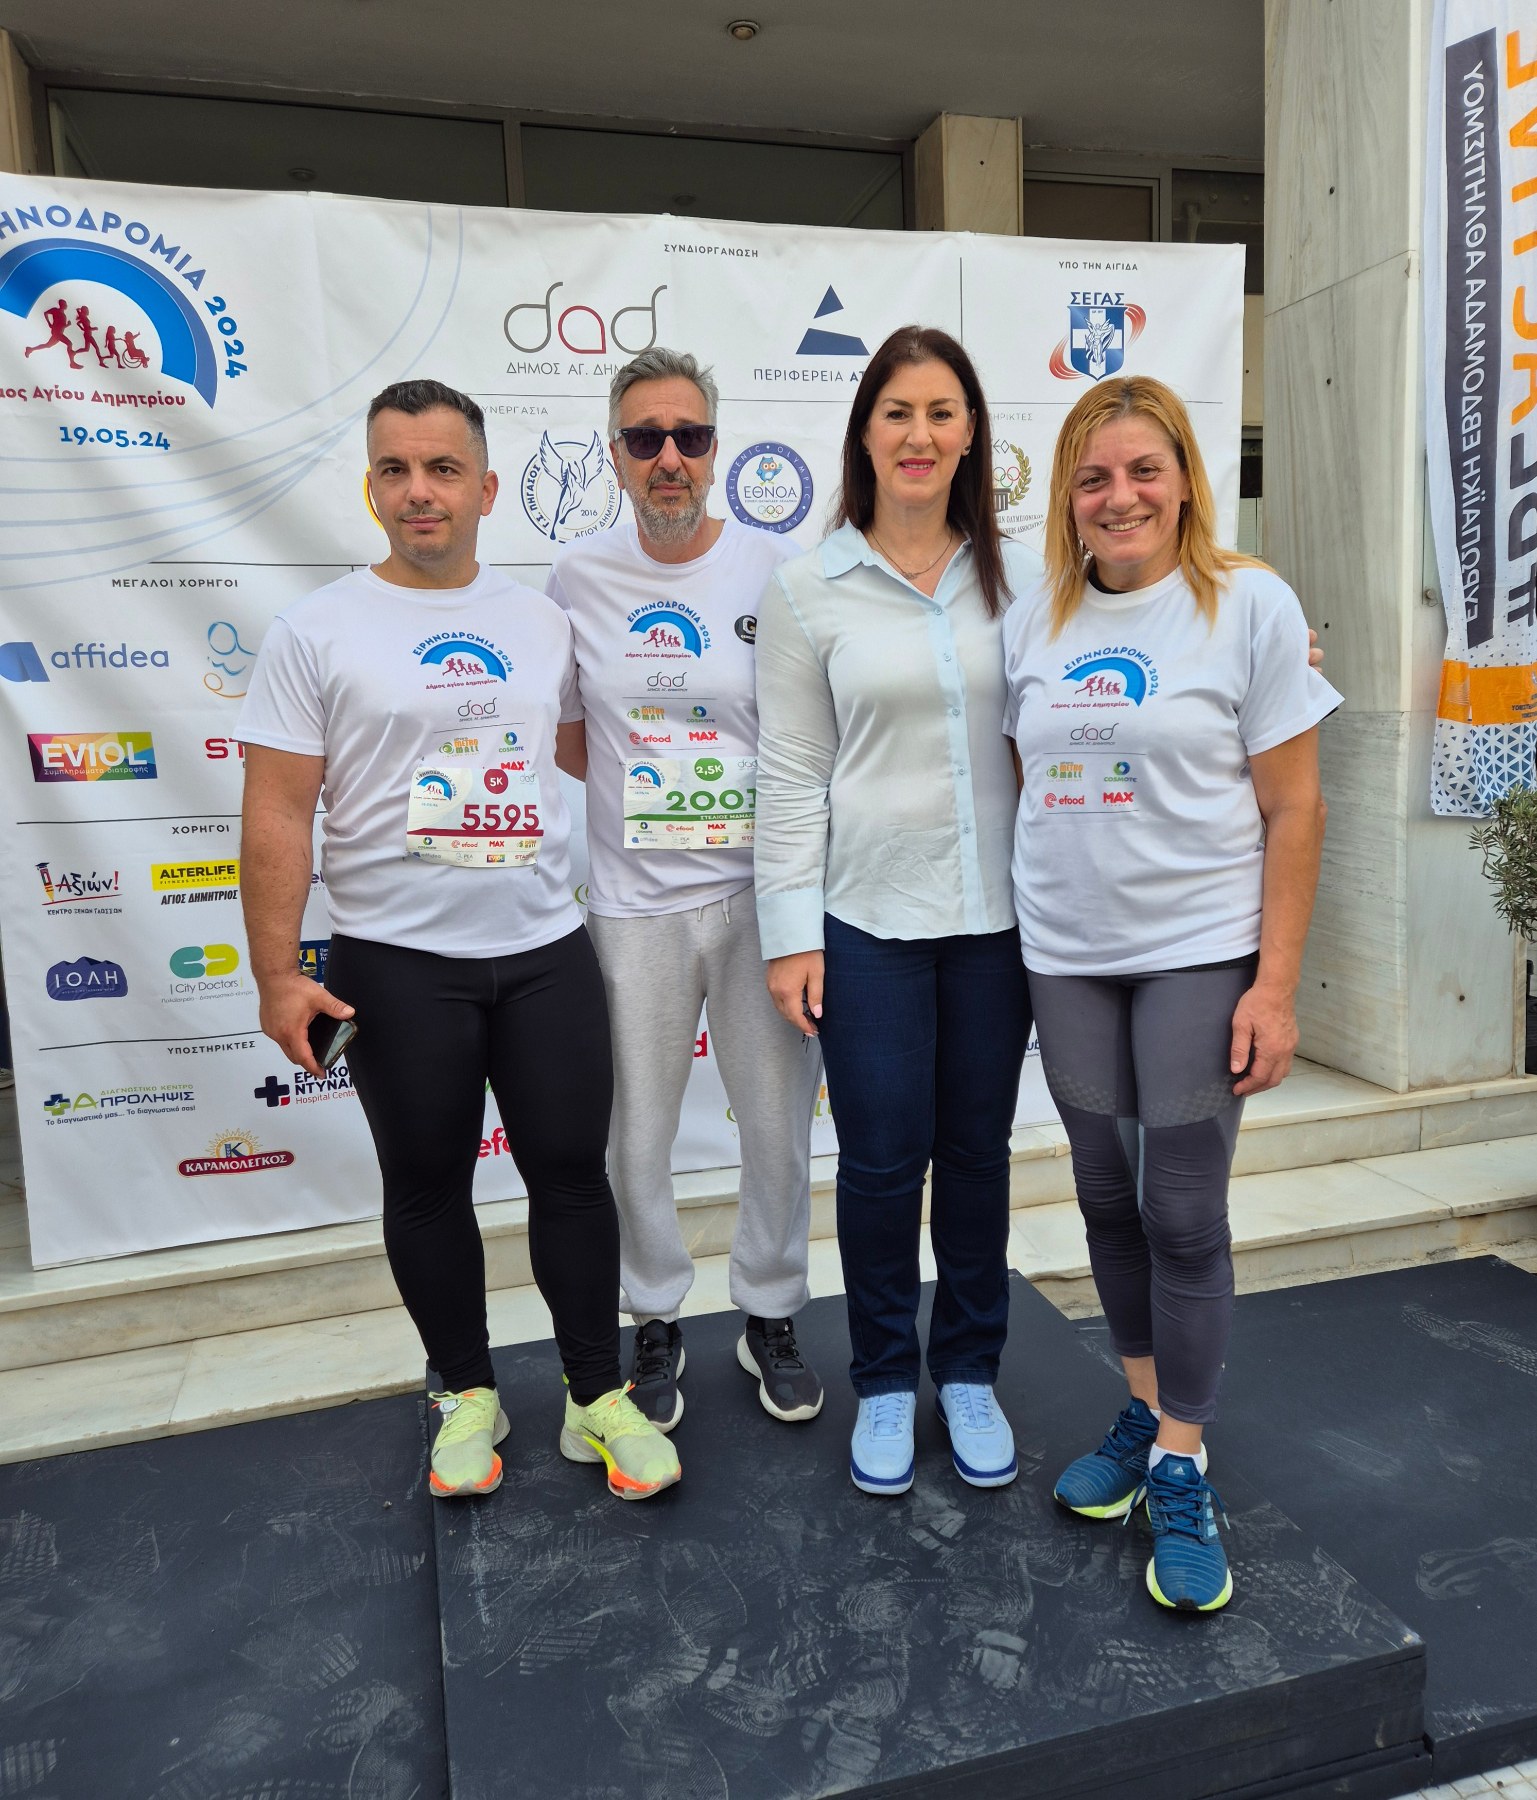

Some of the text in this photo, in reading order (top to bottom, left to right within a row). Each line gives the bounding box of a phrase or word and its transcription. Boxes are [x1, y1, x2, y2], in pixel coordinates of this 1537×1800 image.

[664, 243, 758, 258] ΣΥΝΔΙΟΡΓΑΝΩΣΗ
[1059, 261, 1138, 271] ΥΠΟ ΤΗΝ ΑΙΓΙΔΑ
[0, 205, 248, 379] ΗΝΟΔΡΟΜΙΑ 2024
[1070, 291, 1125, 306] ΣΕΓΑΣ
[506, 362, 560, 375] ΔΗΜΟΣ
[567, 363, 589, 376] ΑΓ.
[754, 368, 844, 382] ΠΕΡΙΦΕΡΕΙΑ
[33, 385, 85, 402] Αγίου
[91, 389, 186, 407] Δημητρίου
[481, 405, 549, 416] ΥΝΕΡΓΑΣΙΑ
[60, 426, 171, 450] 19.05.24
[729, 445, 761, 500] HELLENIC
[777, 446, 811, 500] OLYMPIC
[526, 463, 541, 511] ΠΗΓΑΣΟΣ
[580, 509, 598, 517] 2016
[112, 579, 238, 587] ΜΕΓΑΛΟΙ ΧΟΡΗΓΟΙ
[627, 601, 711, 650] ΕΙΡΗΝΟΔΡΟΜΙΑ 2024
[51, 643, 169, 669] affidea
[412, 632, 514, 673] ΕΙΡΗΝΟΔΡΟΜΙΑ 2024
[1064, 646, 1159, 696] ΕΙΡΗΝΟΔΡΟΜΙΑ 2024
[642, 734, 671, 743] efood
[688, 731, 718, 741] MAX
[41, 742, 147, 768] EVIOL
[44, 766, 149, 777] Συμπληρώματα διατροφής
[500, 760, 525, 771] MAX
[696, 764, 723, 776] 2,5K
[489, 777, 503, 787] 5K
[1059, 795, 1085, 805] efood
[1103, 791, 1134, 803] MAX
[461, 804, 540, 831] 5595
[172, 825, 230, 834] ΧΟΡΗΓΟΙ
[489, 840, 505, 848] MAX
[160, 865, 235, 879] ALTERLIFE
[161, 890, 239, 905] ΑΓΙΟΣ ΔΗΜΗΤΡΙΟΣ
[55, 971, 118, 989] ΙΟΛΗ
[175, 979, 239, 994] City Doctors
[167, 1041, 256, 1054] ΥΠΟΣΤΗΡΙΚΤΕΣ
[100, 1086, 157, 1096] ΔΙΑΓΝΩΣΤΙΚΟ
[295, 1093, 330, 1105] Hospital
[185, 1154, 288, 1172] ΚΑΡΑΜΟΛΕΓΚΟΣ
